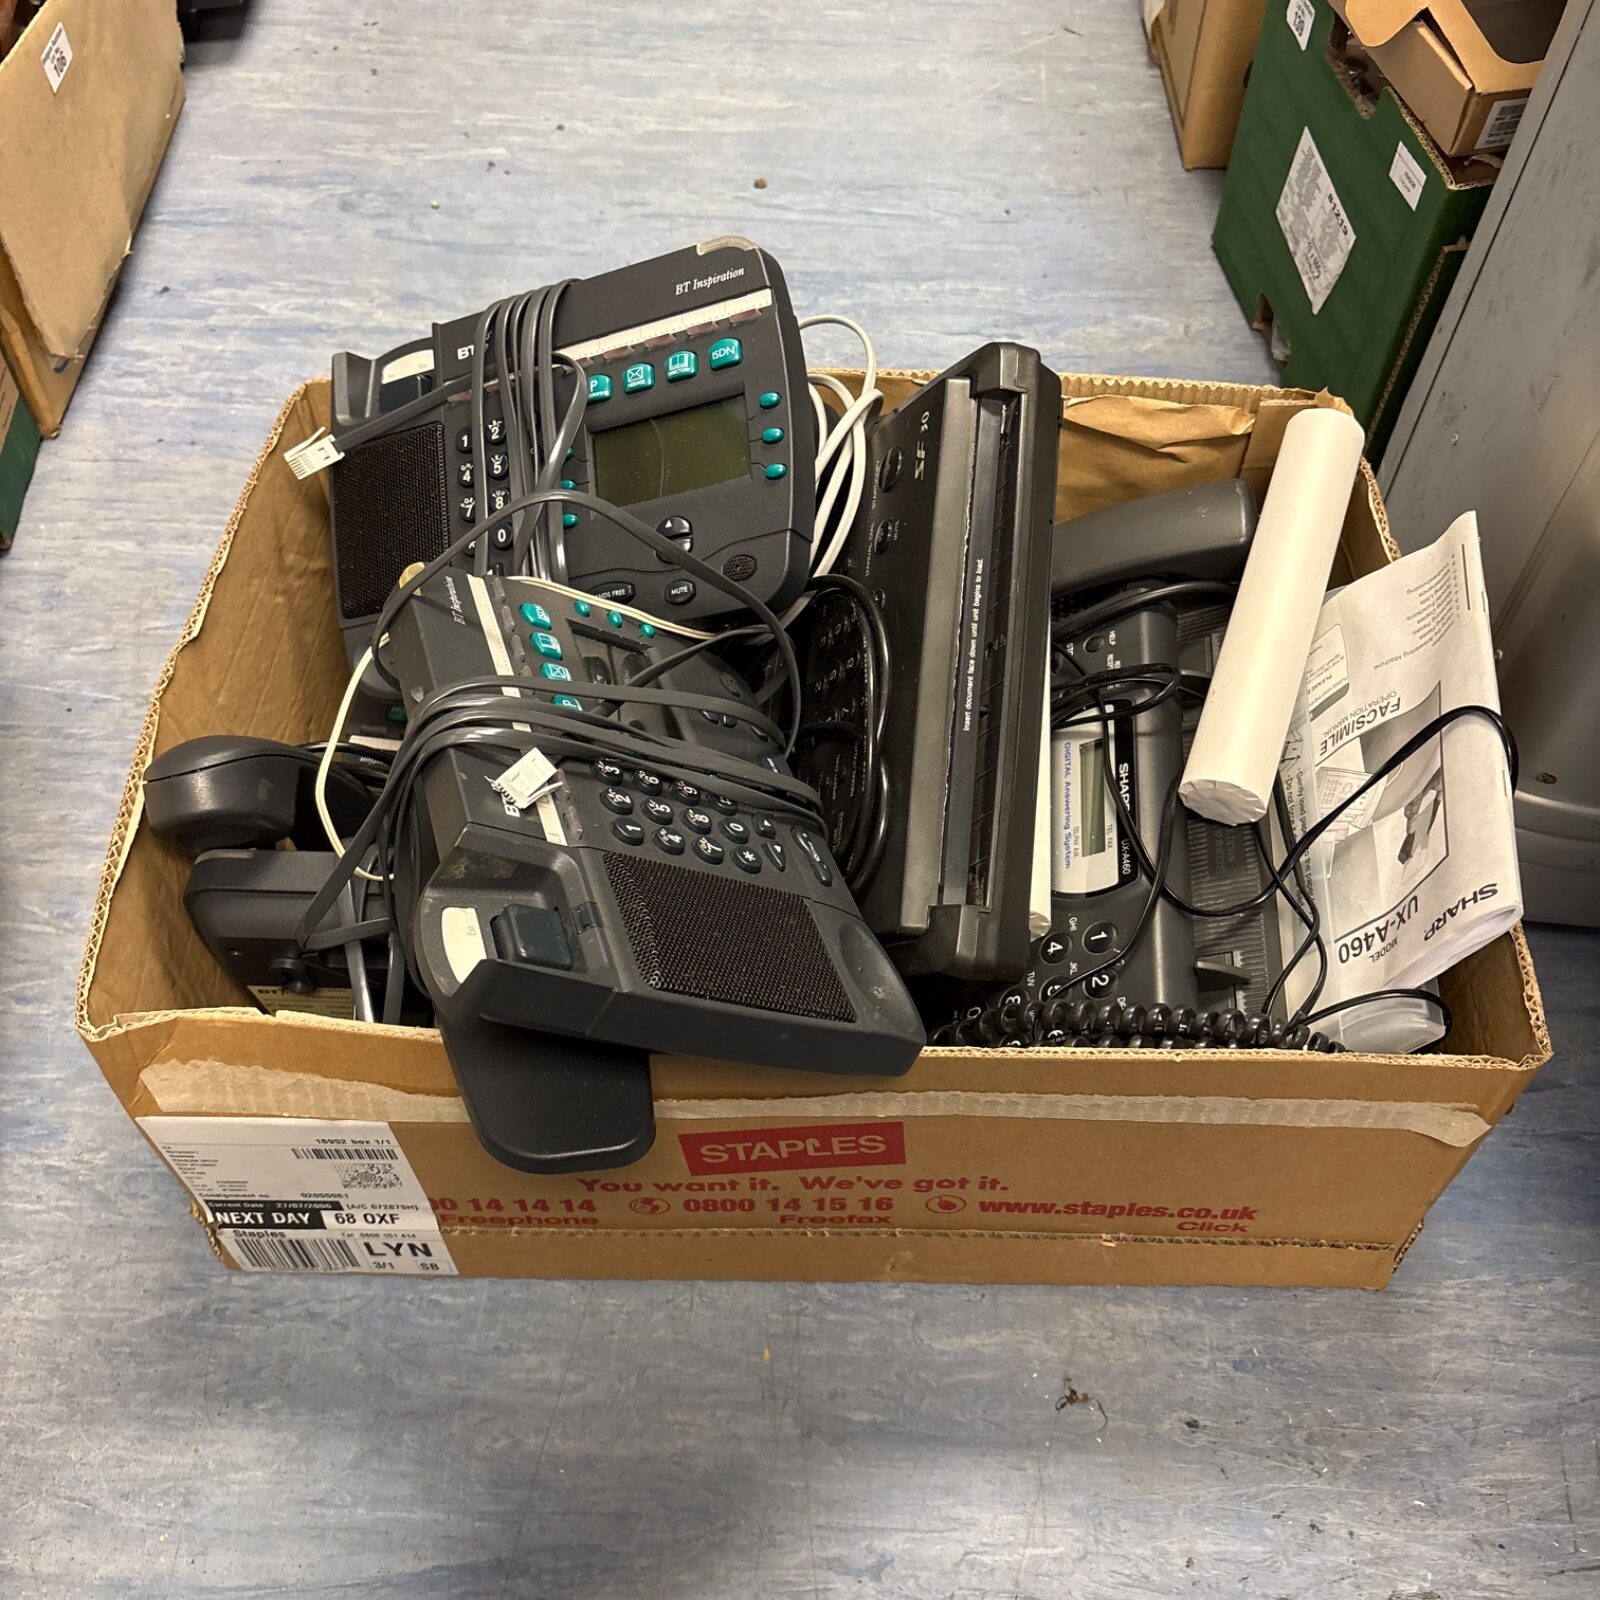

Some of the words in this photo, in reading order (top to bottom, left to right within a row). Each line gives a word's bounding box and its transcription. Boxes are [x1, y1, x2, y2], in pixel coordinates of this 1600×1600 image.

[675, 281, 691, 295] BT
[692, 267, 745, 289] Inspiration
[712, 346, 735, 360] ISDN
[590, 380, 599, 393] P
[462, 435, 468, 448] 1
[493, 462, 502, 475] 5
[463, 473, 472, 483] 4
[495, 498, 504, 510] 8
[498, 529, 507, 543] 0
[975, 575, 982, 583] to
[612, 588, 626, 597] FREE
[671, 586, 688, 595] MUTE
[973, 584, 981, 607] begins
[965, 675, 974, 711] document
[1350, 690, 1397, 719] OPERATION
[963, 711, 971, 732] Insert
[1320, 697, 1400, 756] FACSIMILE
[1322, 715, 1349, 738] MANUAL
[1064, 742, 1072, 779] DIGITAL
[1286, 777, 1293, 790] Do
[1063, 782, 1072, 829] Answering
[694, 814, 710, 824] 8
[626, 824, 641, 832] 1
[729, 823, 744, 832] 0
[1063, 831, 1072, 869] System
[1121, 839, 1131, 875] UX-A460
[1304, 858, 1312, 872] the
[1424, 883, 1498, 941] SHARP
[1091, 931, 1108, 941] 1
[1338, 896, 1419, 964] UX-A460
[1047, 942, 1063, 955] 4
[1369, 937, 1398, 963] MODEL
[1092, 975, 1109, 988] 2
[700, 1135, 887, 1163] STAPLES
[576, 1179, 642, 1193] You
[652, 1180, 740, 1193] want
[750, 1177, 781, 1191] it.
[799, 1176, 903, 1190] We've
[913, 1177, 970, 1193] got
[978, 1175, 1009, 1191] it.
[467, 1198, 504, 1212] 14
[514, 1198, 550, 1212] 14
[560, 1198, 597, 1212] 14
[683, 1198, 755, 1212] 0800
[768, 1198, 802, 1211] 14
[813, 1198, 847, 1211] 15
[857, 1198, 894, 1211] 16
[978, 1199, 1258, 1221] www.staples.co.uk
[215, 1212, 264, 1225] NEXT
[272, 1212, 310, 1225] DAY
[335, 1213, 356, 1225] 68
[439, 1214, 599, 1226] Freephone
[779, 1214, 892, 1225] Freefax
[233, 1229, 286, 1239] Staples
[1176, 1221, 1249, 1233] Click
[364, 1242, 433, 1258] LYN
[372, 1261, 395, 1270] 3/1
